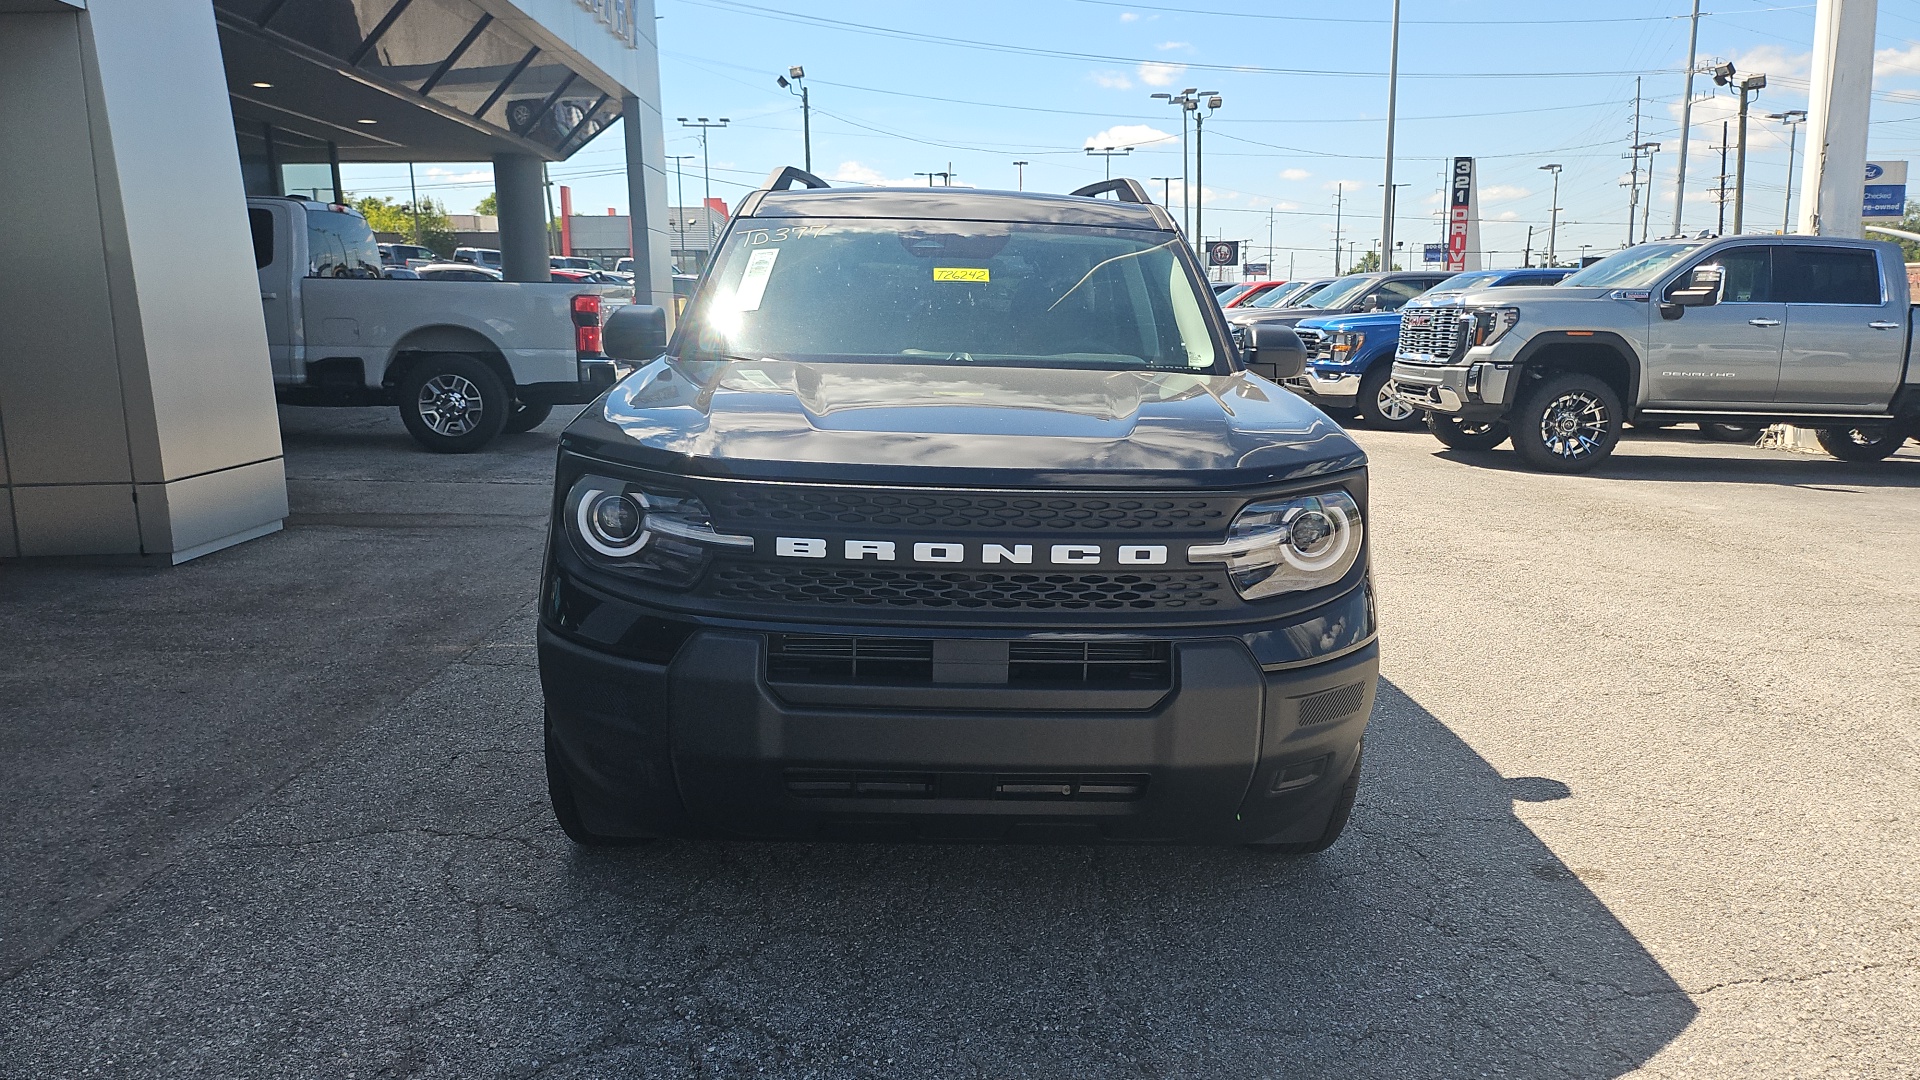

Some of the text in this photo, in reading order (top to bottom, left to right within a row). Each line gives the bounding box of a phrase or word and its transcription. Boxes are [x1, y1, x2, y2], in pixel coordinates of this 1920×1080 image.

[1454, 161, 1471, 203] 321
[937, 270, 986, 280] T26242
[776, 536, 1168, 565] BRONCO
